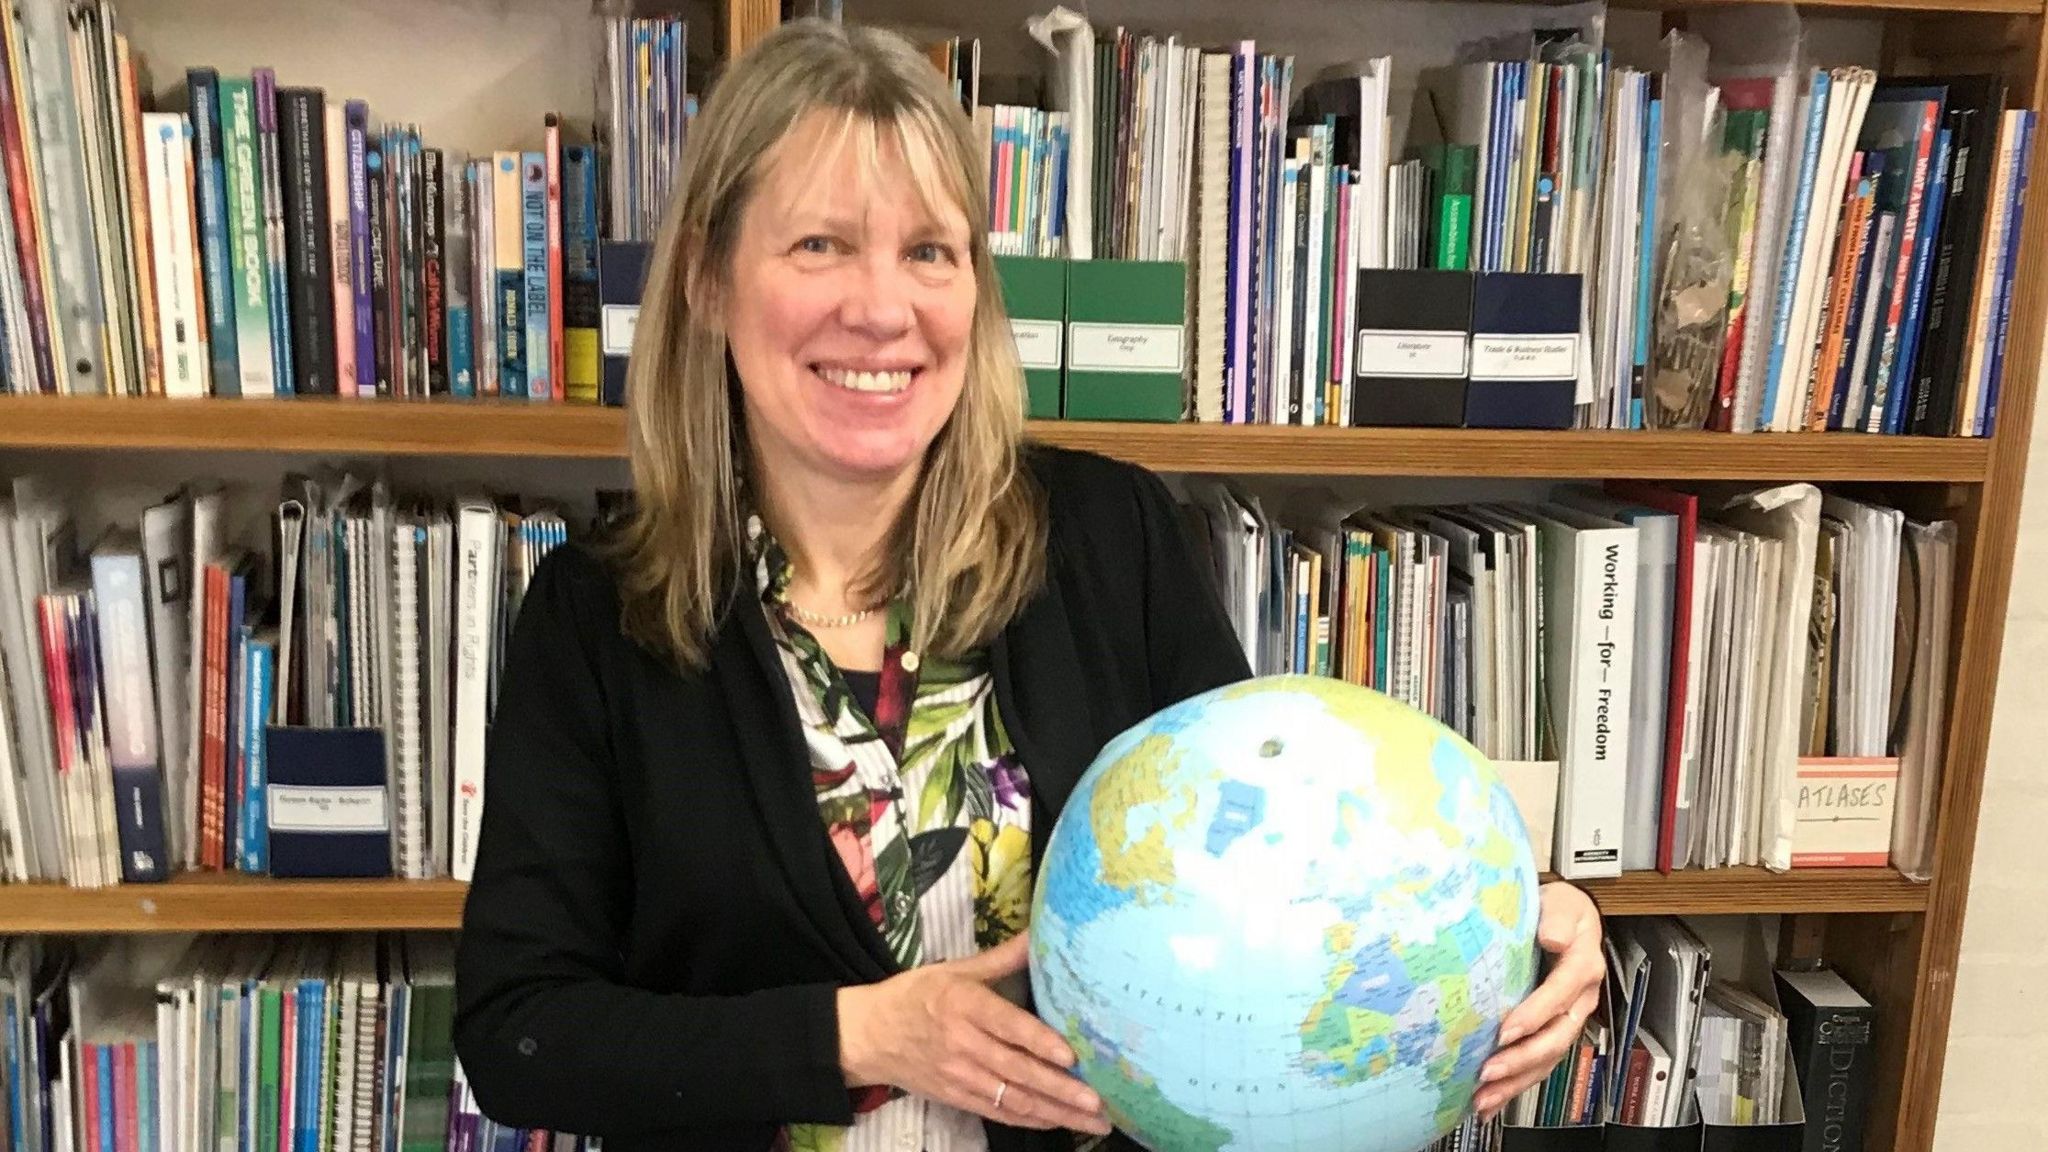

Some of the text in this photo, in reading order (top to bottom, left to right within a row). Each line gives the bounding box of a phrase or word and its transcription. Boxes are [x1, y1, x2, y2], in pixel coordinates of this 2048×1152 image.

[233, 87, 261, 307] THE GREEN BOOK
[351, 128, 365, 212] CITIZENSHIP
[1909, 189, 1923, 203] A
[1912, 156, 1929, 188] WHAT
[306, 228, 314, 248] THE
[525, 190, 547, 317] NOT ON THE LABEL
[1598, 544, 1620, 620] Working
[1595, 688, 1612, 761] Freedom
[1798, 783, 1887, 808] ATLASES
